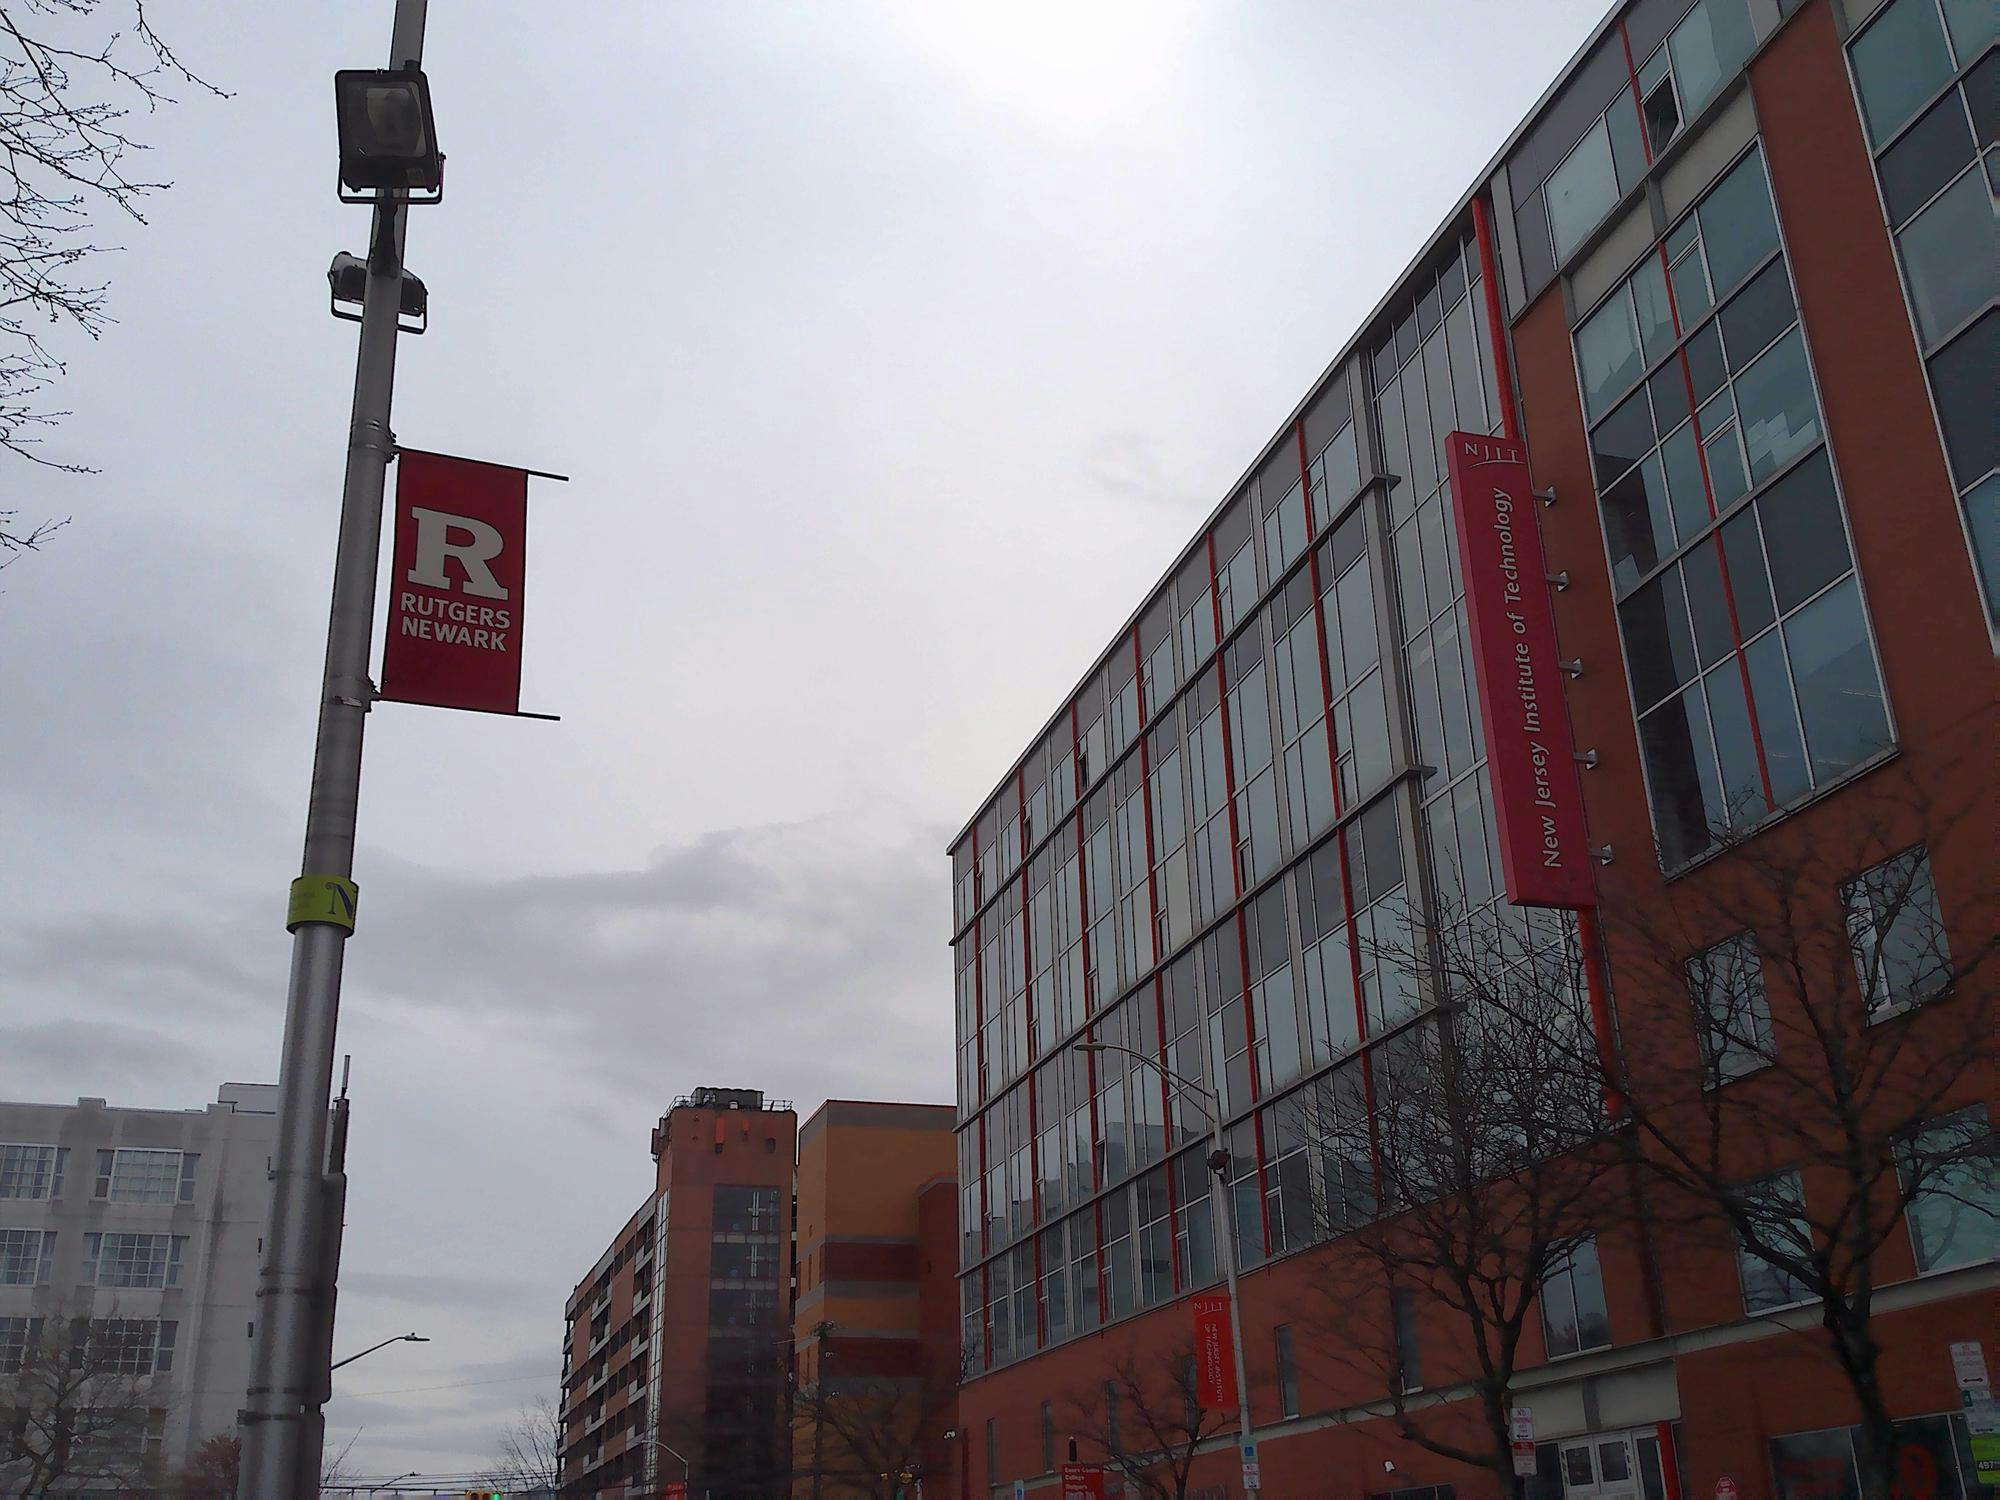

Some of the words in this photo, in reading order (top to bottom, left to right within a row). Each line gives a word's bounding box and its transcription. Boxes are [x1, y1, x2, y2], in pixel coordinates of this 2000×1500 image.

[1464, 441, 1519, 463] NJIT
[407, 506, 509, 601] R
[1493, 487, 1520, 604] Technology
[400, 591, 511, 629] RUTGERS
[401, 616, 507, 652] NEWARK
[1506, 612, 1528, 635] of
[1515, 642, 1541, 733] Institute
[1530, 741, 1556, 808] Jersey
[1541, 815, 1562, 868] New
